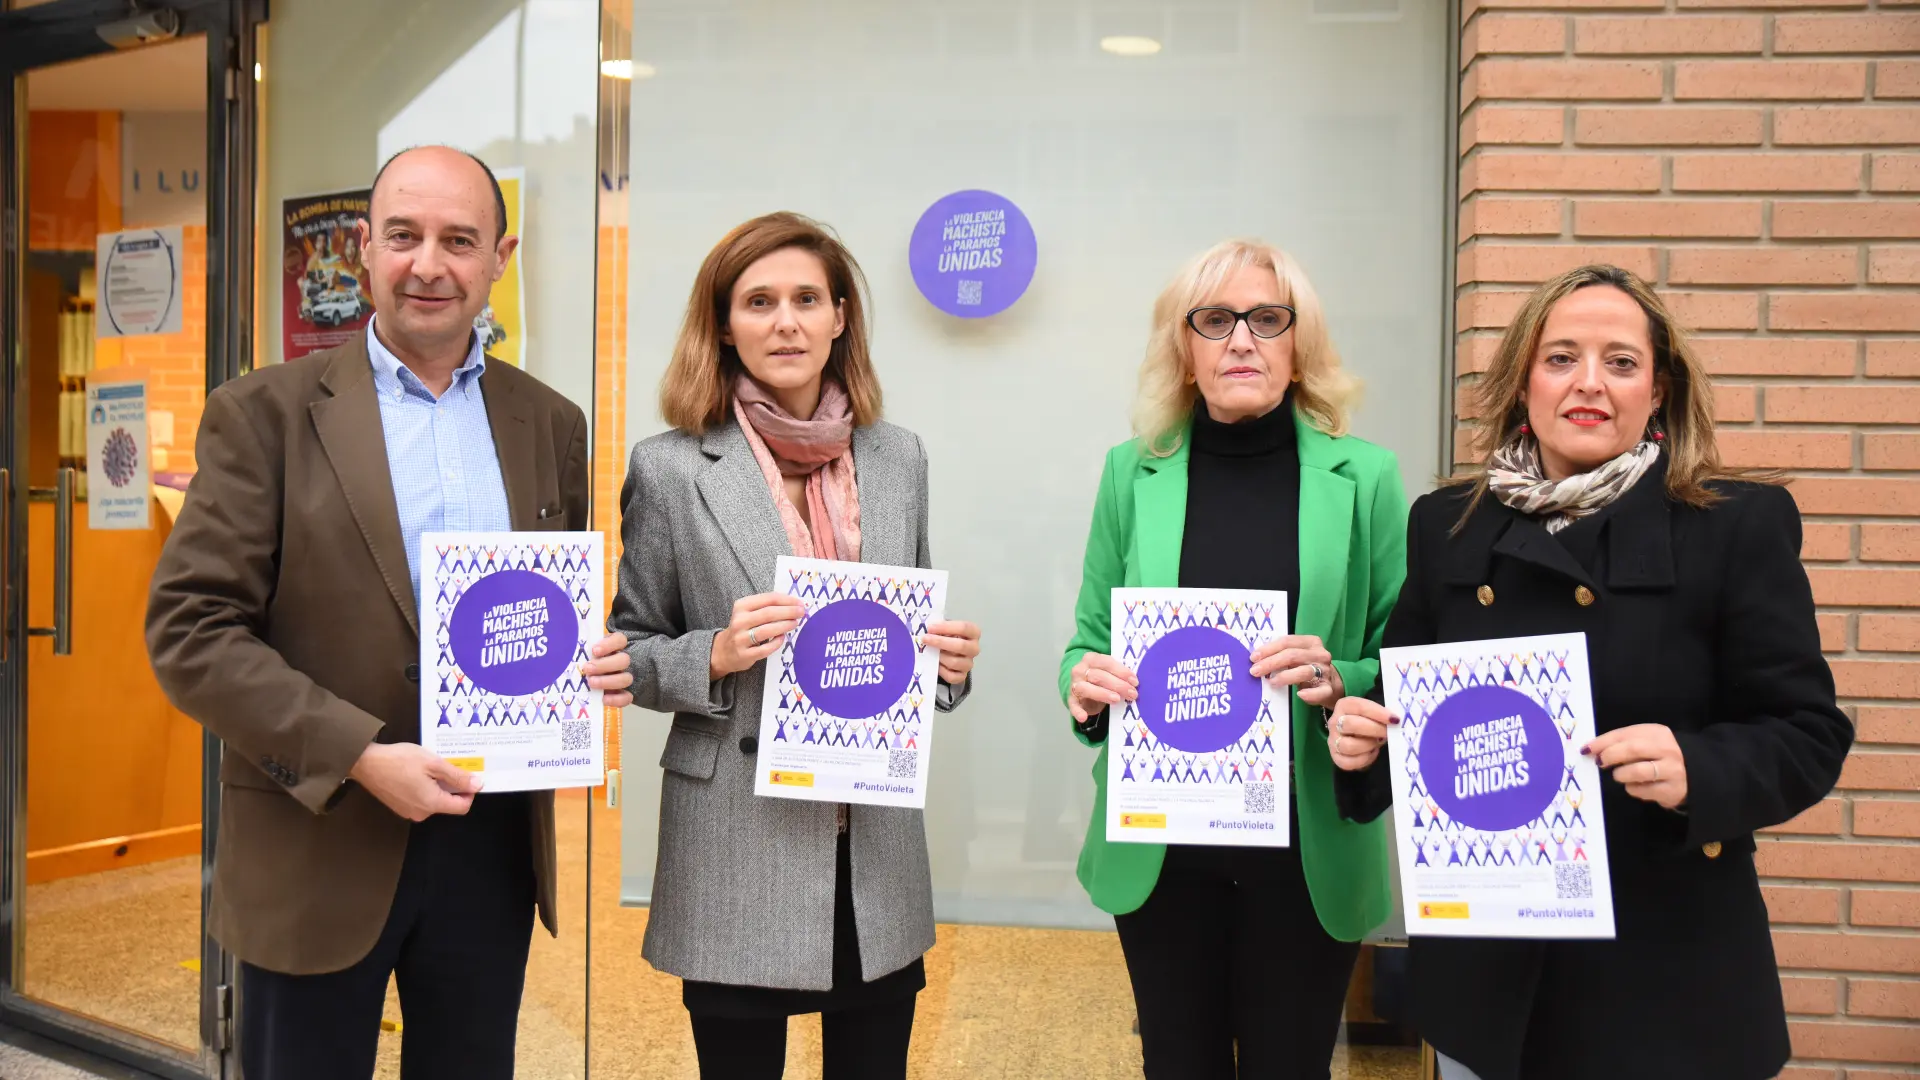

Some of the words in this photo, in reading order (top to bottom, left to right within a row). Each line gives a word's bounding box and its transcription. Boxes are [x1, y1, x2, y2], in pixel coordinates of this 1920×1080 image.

[286, 211, 300, 226] LA
[953, 209, 1004, 225] VIOLENCIA
[943, 221, 1006, 241] MACHISTA
[944, 244, 952, 253] LA
[953, 236, 1000, 252] PARAMOS
[938, 248, 1003, 273] UNIDAS
[484, 611, 493, 619] LA
[492, 596, 547, 618] VIOLENCIA
[482, 608, 549, 635] MACHISTA
[485, 638, 494, 646] LA
[495, 624, 544, 645] PARAMOS
[836, 627, 887, 642] VIOLENCIA
[480, 636, 548, 668] UNIDAS
[824, 638, 888, 657] MACHISTA
[826, 661, 834, 669] LA
[835, 653, 882, 668] PARAMOS
[1168, 666, 1177, 674] LA
[1176, 653, 1230, 673] VIOLENCIA
[820, 664, 885, 689] UNIDAS
[1167, 665, 1233, 690] MACHISTA
[1169, 693, 1178, 702] LA
[1178, 681, 1228, 701] PARAMOS
[1164, 693, 1232, 724] UNIDAS
[1453, 733, 1464, 743] LA
[1462, 713, 1524, 741] VIOLENCIA
[1454, 727, 1529, 762] MACHISTA
[528, 757, 591, 768] #PuntoVioleta
[1457, 763, 1468, 774] LA
[1468, 746, 1524, 772] PARAMOS
[853, 781, 914, 794] #PuntoVioleta
[1454, 760, 1530, 800] UNIDAS
[1209, 820, 1274, 830] #PuntoVioleta
[1517, 907, 1595, 918] #PuntoVioleta
